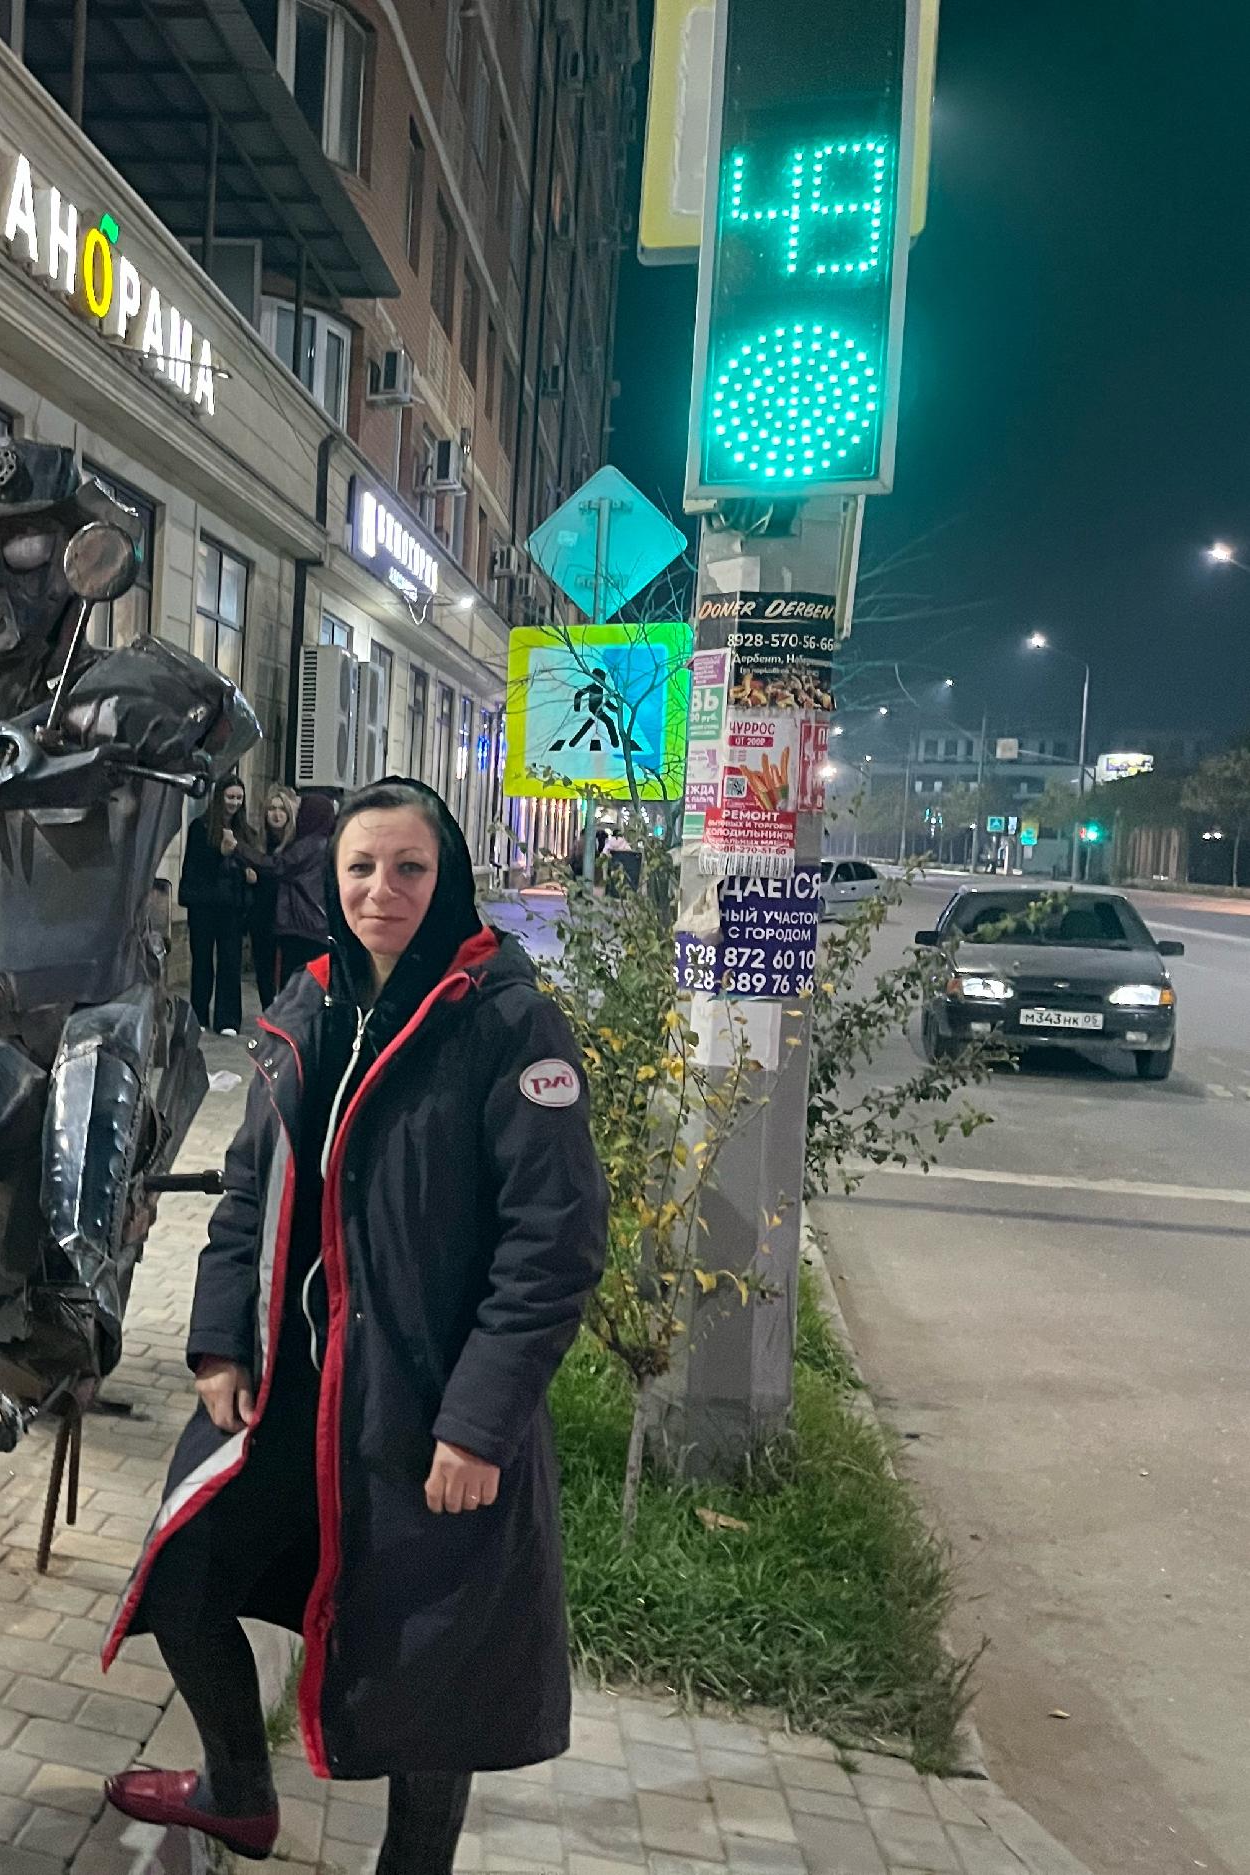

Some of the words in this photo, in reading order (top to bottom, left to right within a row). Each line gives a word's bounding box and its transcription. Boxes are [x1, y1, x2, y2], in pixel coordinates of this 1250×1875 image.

[730, 141, 887, 275] 49
[699, 600, 756, 620] DONER
[764, 599, 835, 620] DERBEN
[727, 632, 834, 651] 8928-570-56-66
[730, 721, 776, 735] ЧУРРОС
[722, 809, 780, 822] РЕМОНТ
[728, 926, 741, 939] С
[745, 927, 811, 942] ГОРОДОМ
[723, 946, 766, 969] 872
[772, 949, 795, 970] 60
[798, 950, 816, 970] 10
[771, 974, 791, 995] 76
[795, 974, 814, 995] 36
